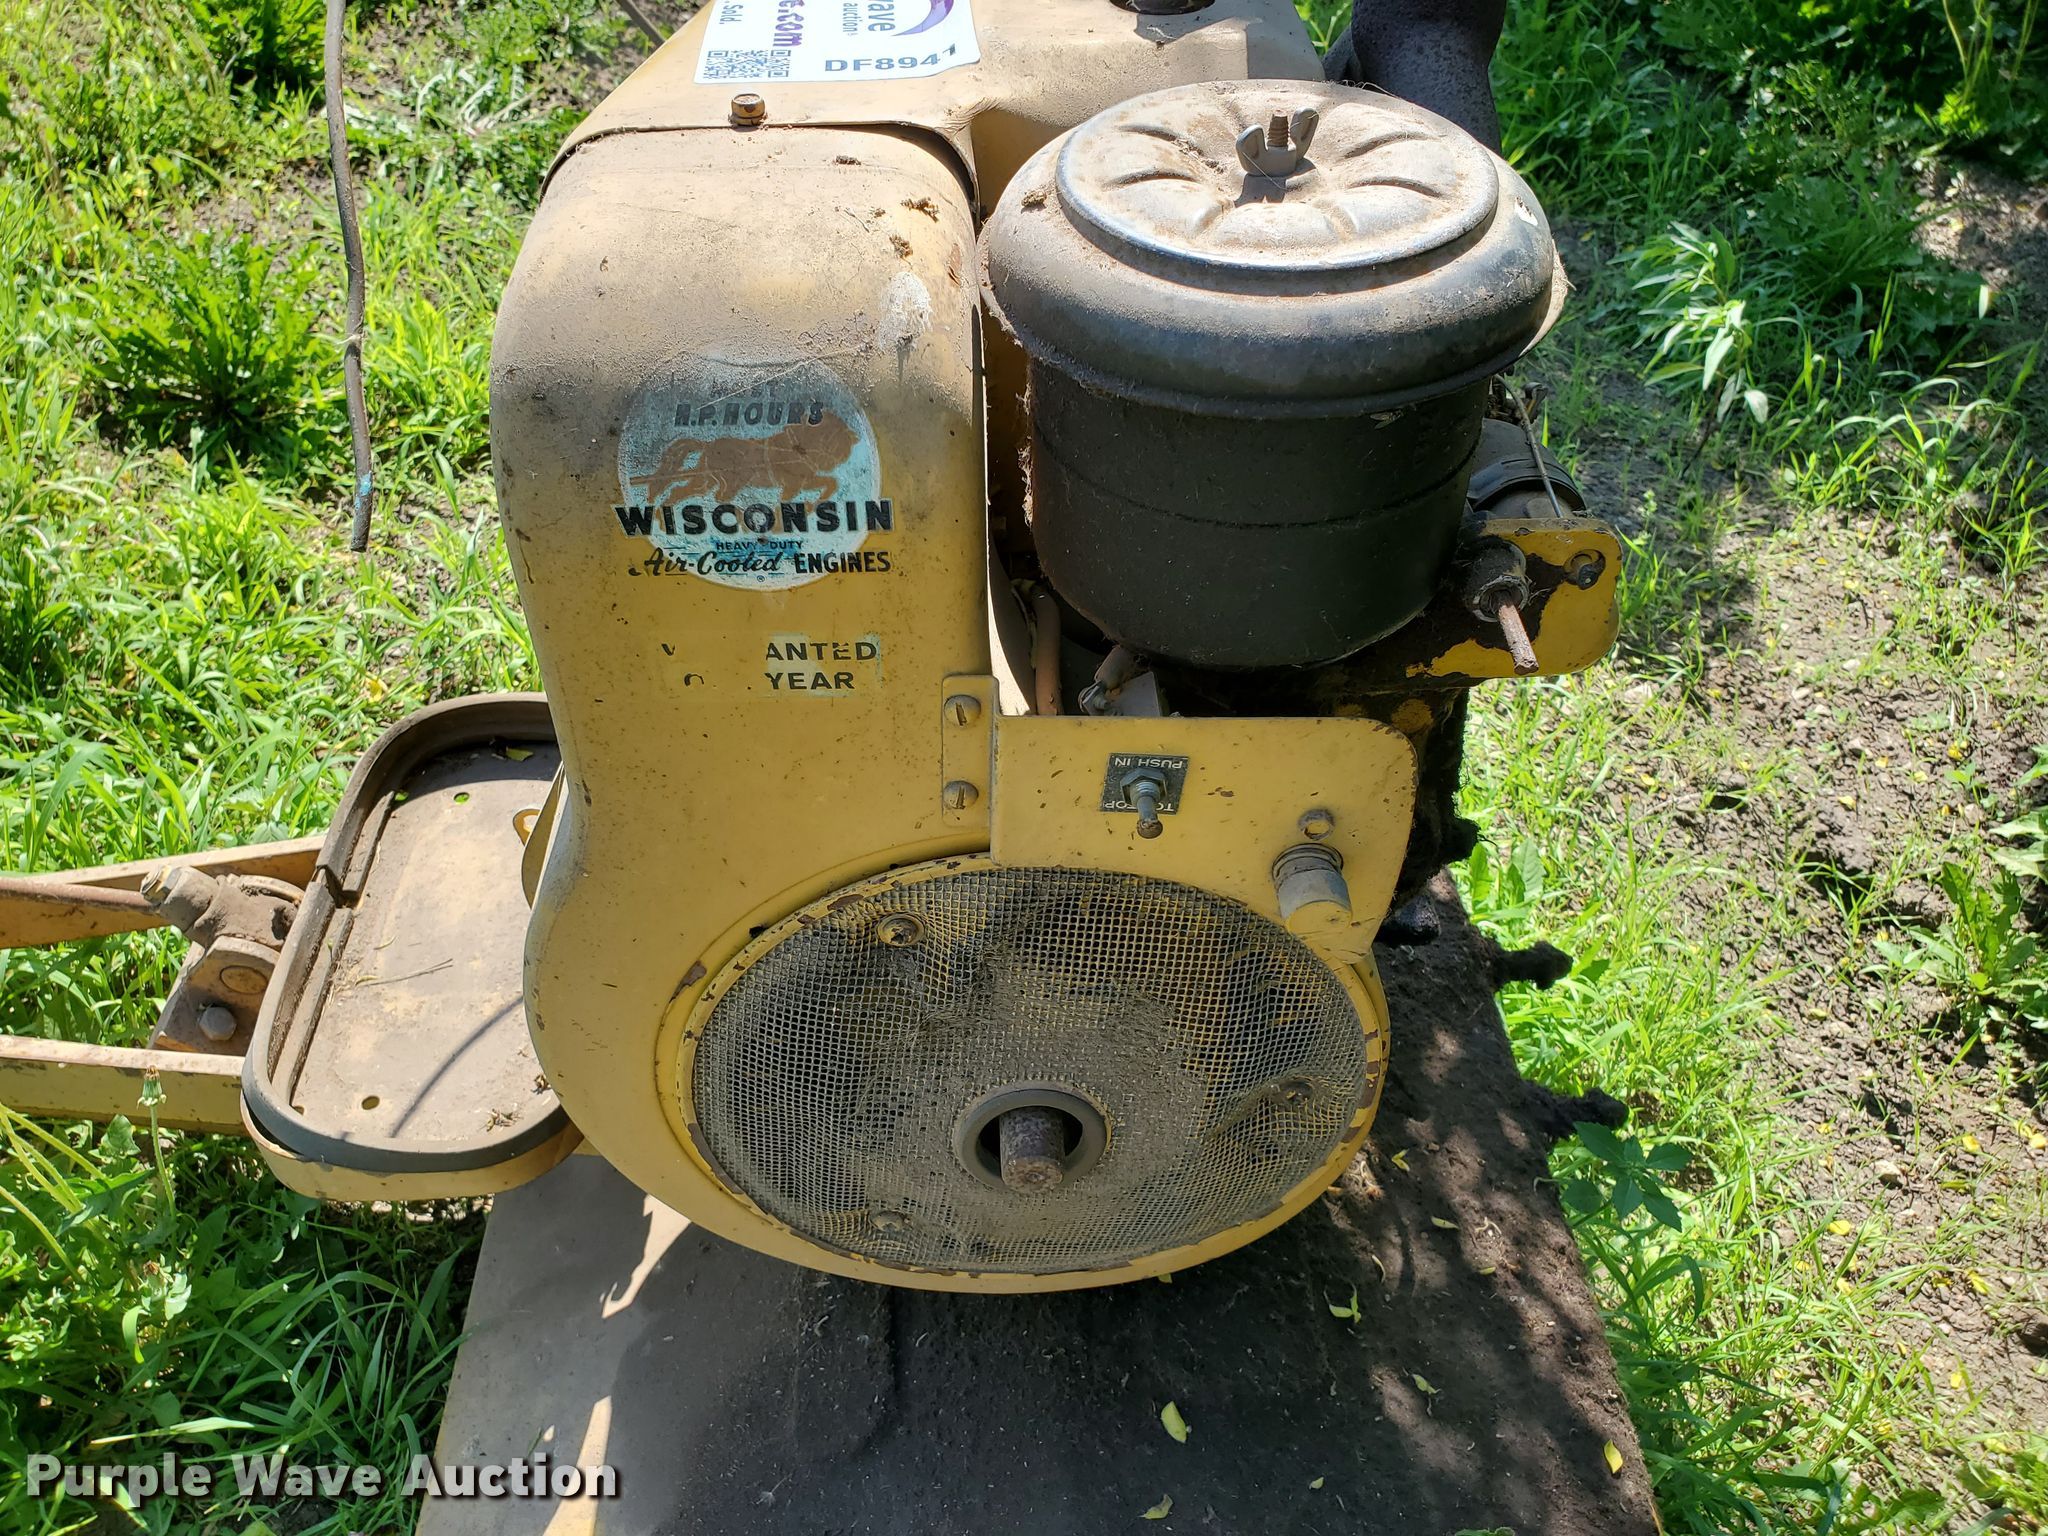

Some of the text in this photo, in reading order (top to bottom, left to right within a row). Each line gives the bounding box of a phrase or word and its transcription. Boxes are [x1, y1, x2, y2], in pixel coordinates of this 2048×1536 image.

[825, 43, 956, 71] DF8941
[614, 500, 893, 536] WISCONSIN
[628, 548, 892, 577] Air-Cooled ENGINES
[764, 672, 855, 690] YEAR
[1114, 757, 1184, 769] PUSH IN
